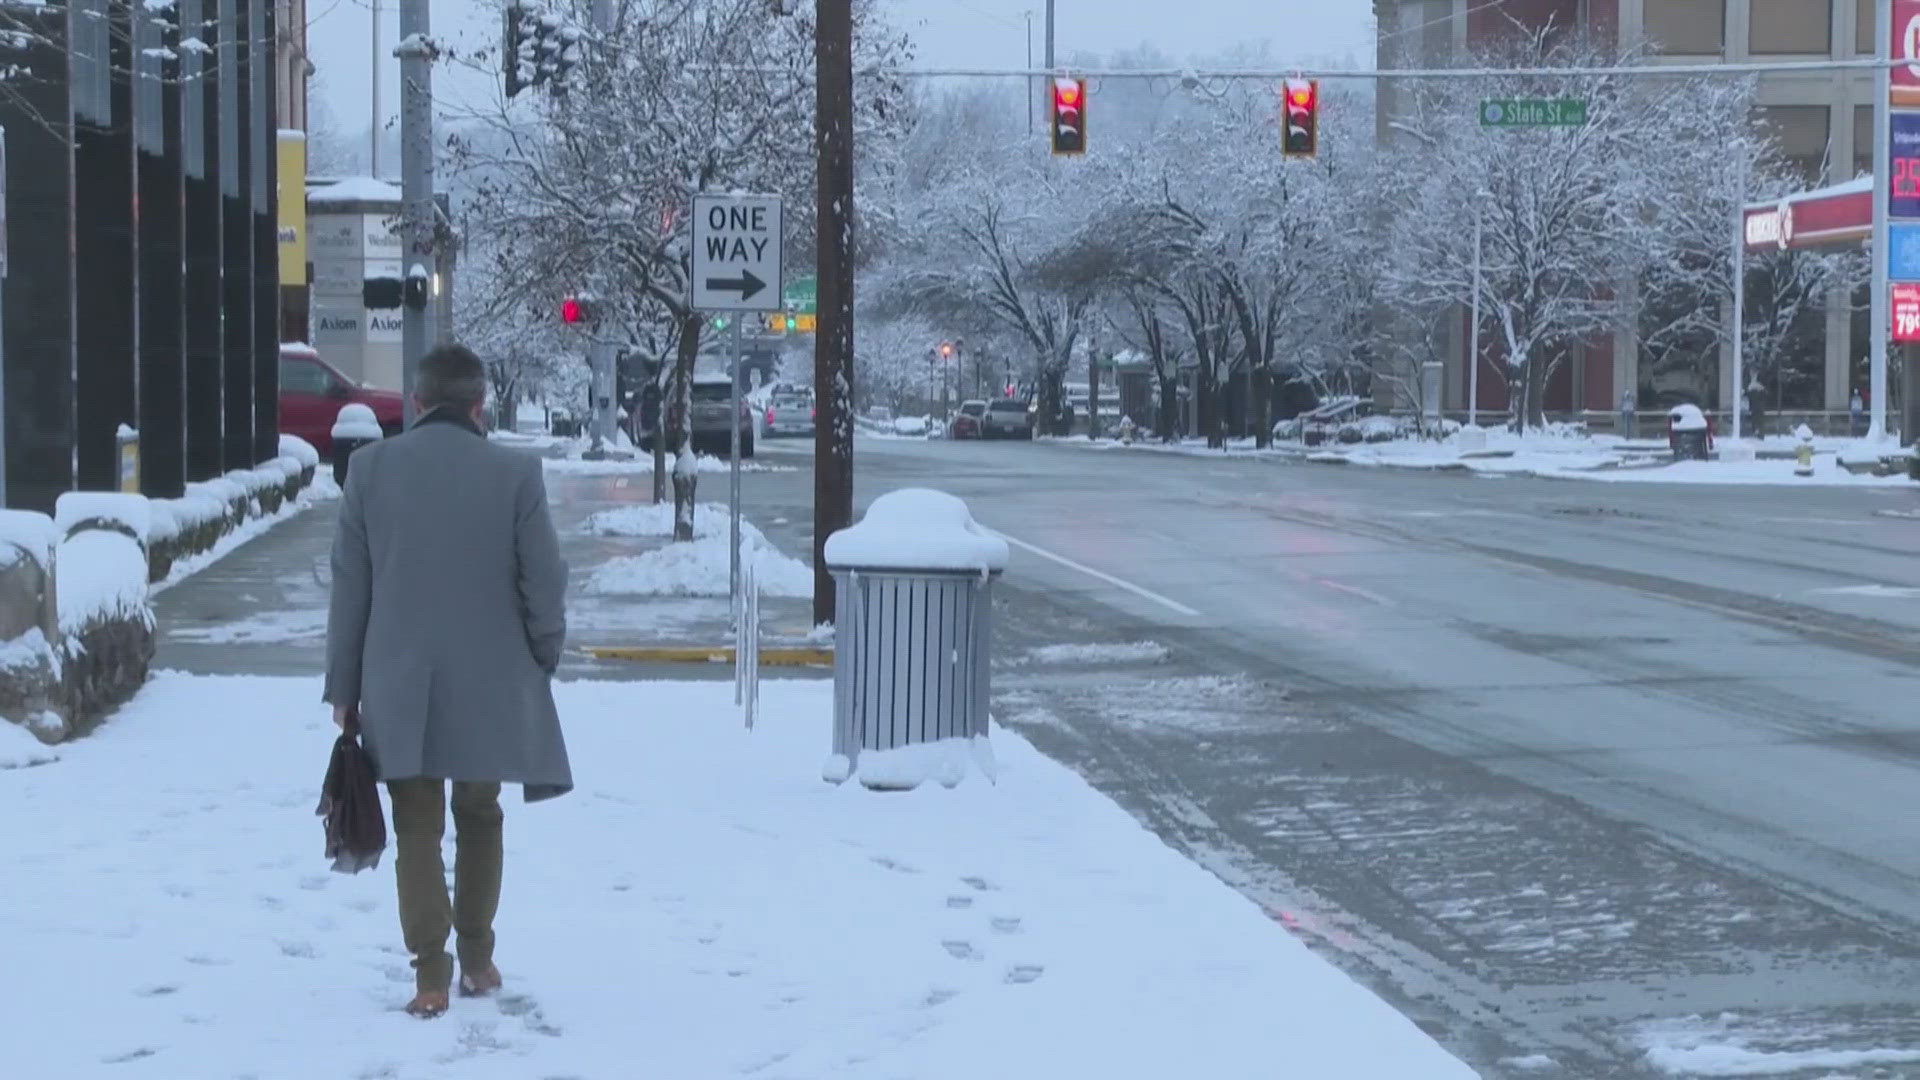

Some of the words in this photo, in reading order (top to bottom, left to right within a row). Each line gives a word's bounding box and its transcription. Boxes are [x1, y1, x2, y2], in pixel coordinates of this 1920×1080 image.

[1507, 102, 1544, 123] State
[1547, 102, 1562, 123] St
[709, 205, 767, 231] ONE
[707, 236, 768, 262] WAY
[320, 317, 357, 330] Axiom
